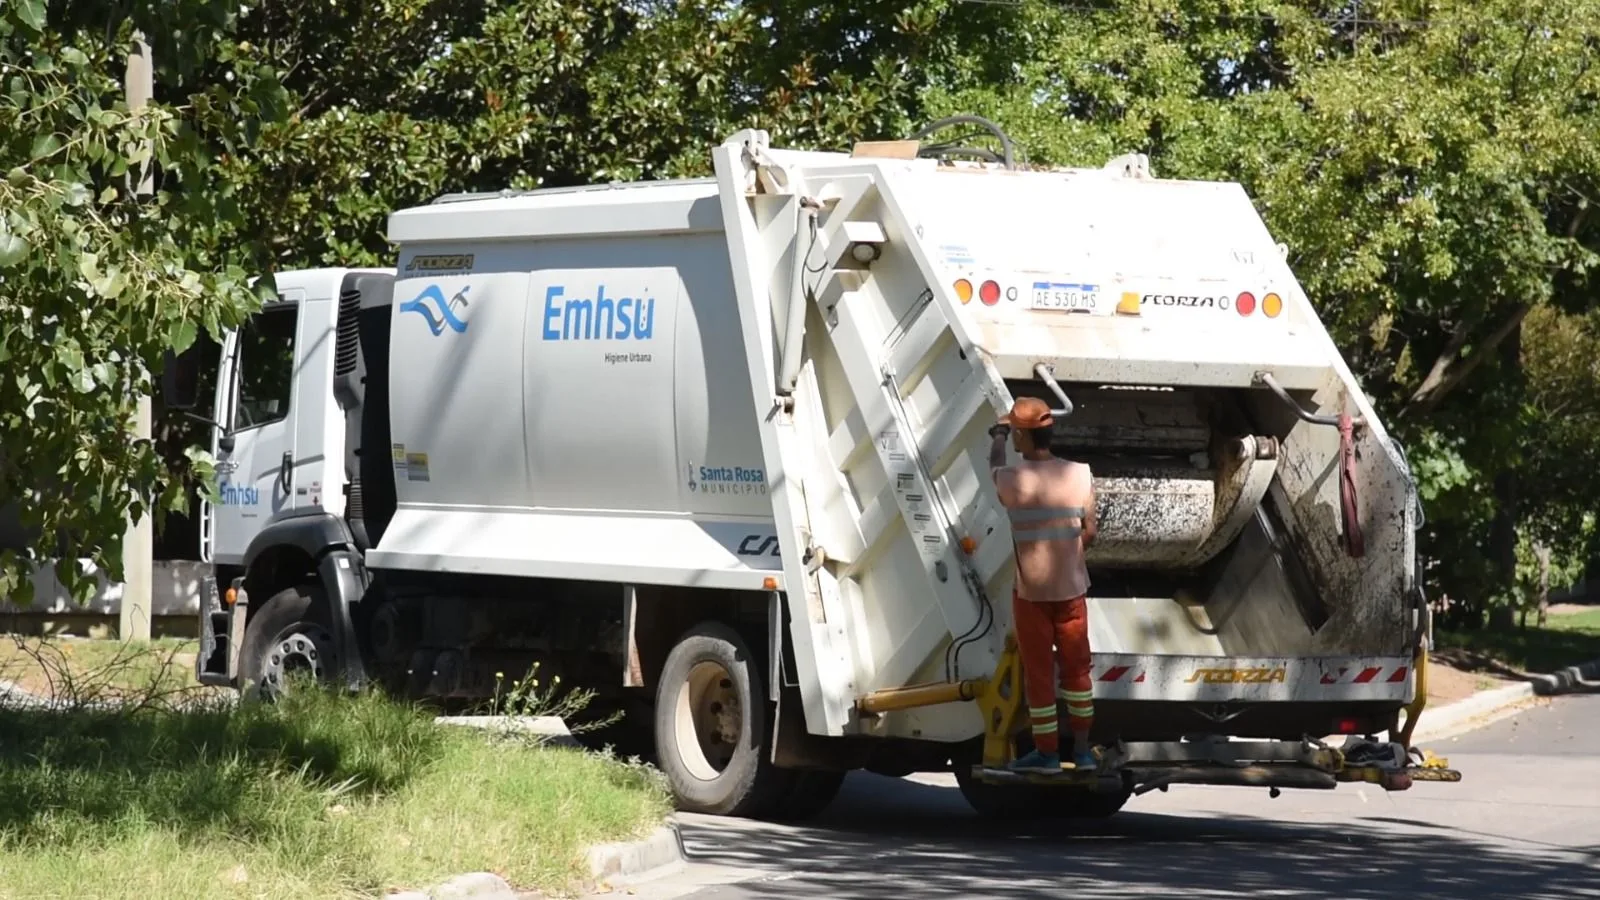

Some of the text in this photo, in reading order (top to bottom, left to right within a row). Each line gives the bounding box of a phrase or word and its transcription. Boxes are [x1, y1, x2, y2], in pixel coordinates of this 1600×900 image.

[1036, 291, 1050, 305] AE
[1055, 292, 1077, 307] 530
[1140, 294, 1214, 307] SCORZA
[604, 352, 652, 365] Higiene Urbana
[700, 466, 764, 482] Santa Rosa
[701, 483, 766, 495] MUNICIPIO
[1184, 668, 1286, 683] SCORZA
